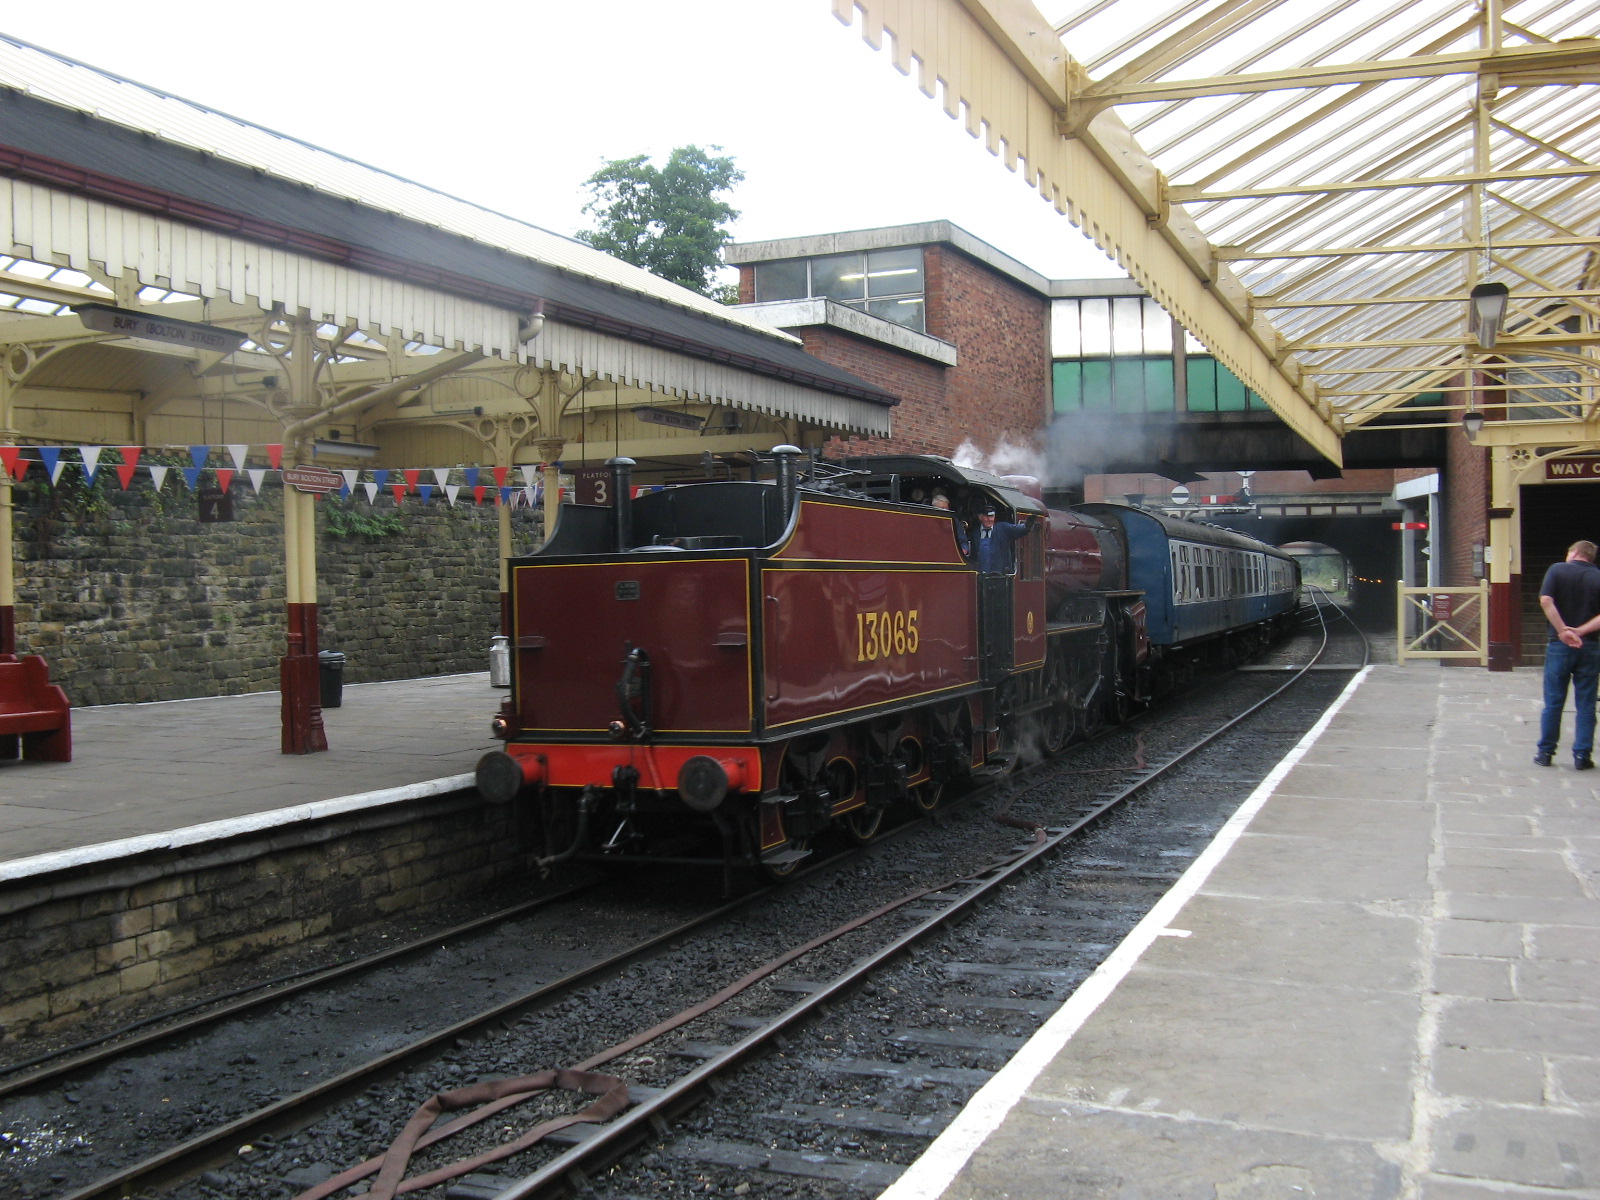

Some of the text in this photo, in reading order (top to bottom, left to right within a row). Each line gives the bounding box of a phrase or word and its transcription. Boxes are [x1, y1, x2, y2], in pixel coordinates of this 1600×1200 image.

[114, 317, 138, 330] BURY
[146, 323, 186, 340] (BOLTON
[286, 472, 339, 484] BURY BOLTON STREET
[1550, 463, 1585, 475] WAY
[594, 480, 607, 503] 3
[210, 502, 219, 519] 4
[856, 610, 919, 662] 13065
